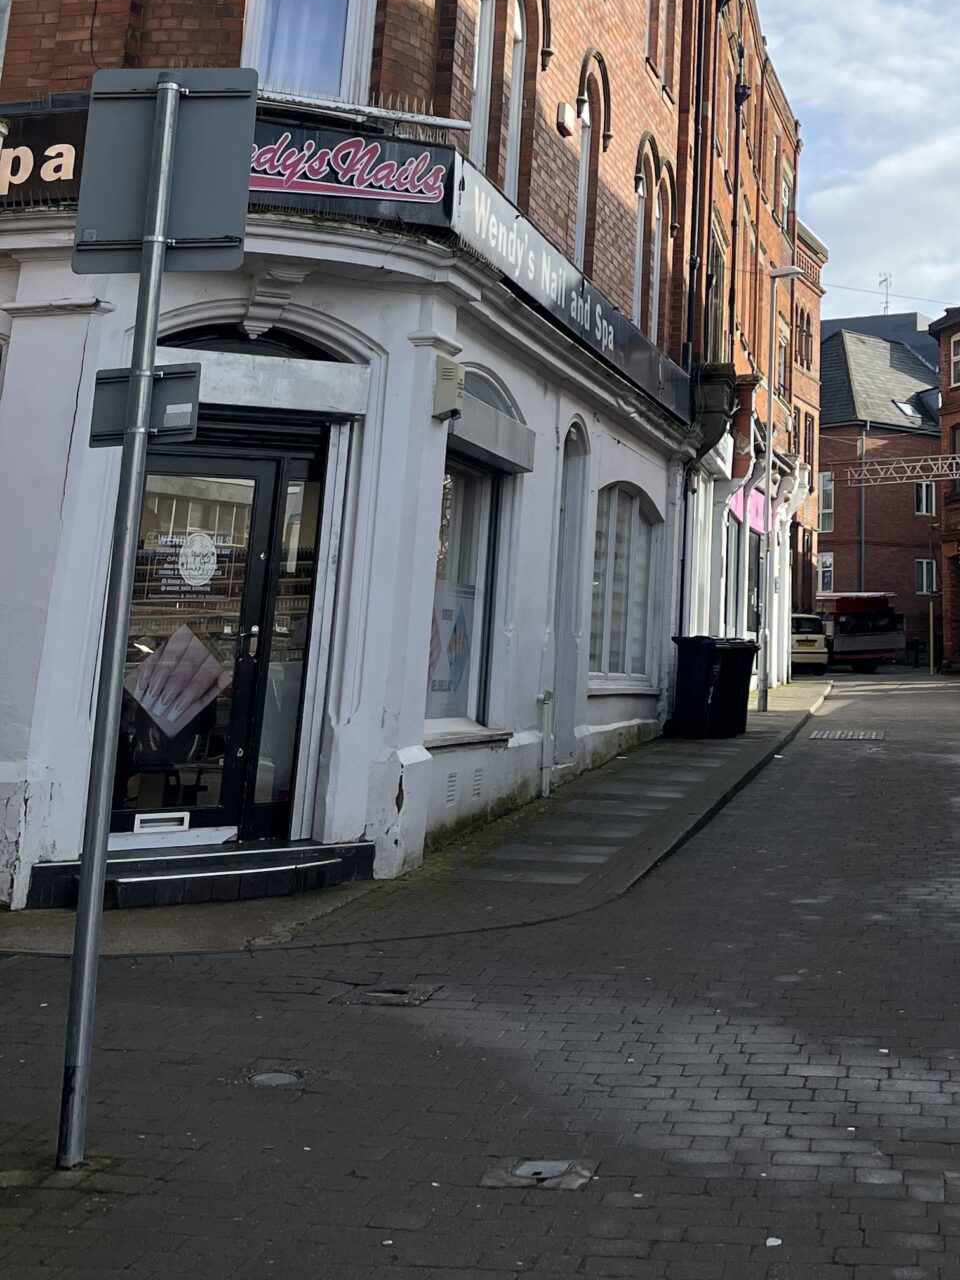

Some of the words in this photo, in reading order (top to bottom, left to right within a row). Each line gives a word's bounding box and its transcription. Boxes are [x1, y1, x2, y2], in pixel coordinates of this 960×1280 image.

[250, 132, 332, 187] dy's
[330, 137, 446, 196] Nails
[474, 184, 535, 281] Wendy's
[541, 250, 567, 309] Nail
[570, 290, 591, 332] and
[595, 303, 614, 352] Spa
